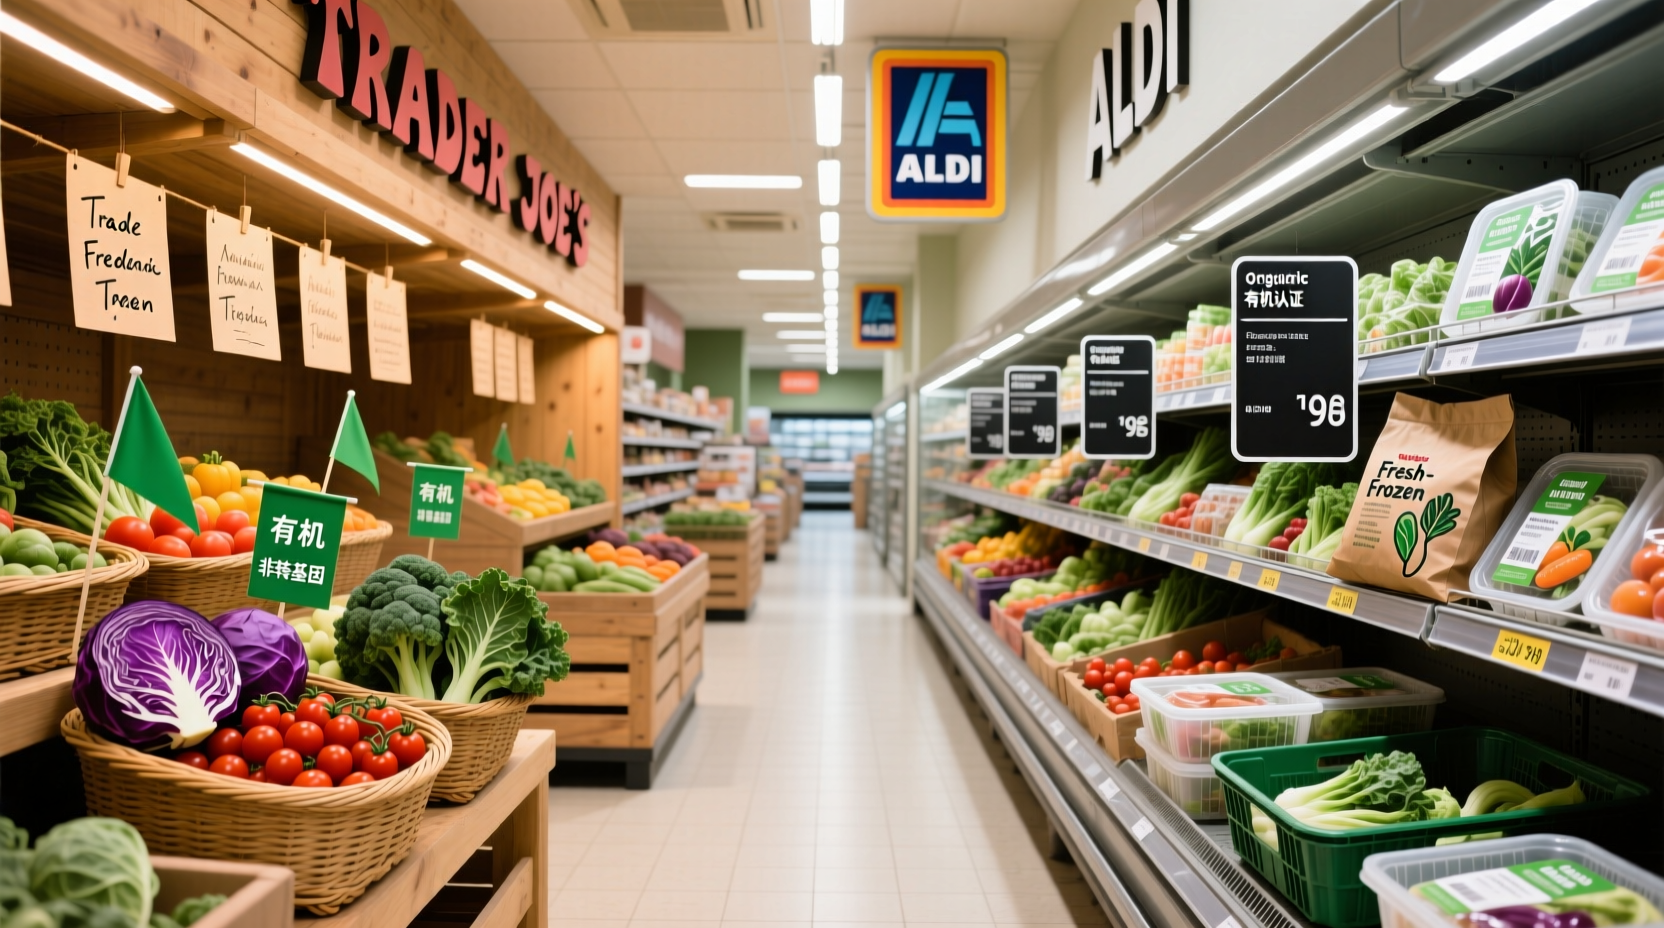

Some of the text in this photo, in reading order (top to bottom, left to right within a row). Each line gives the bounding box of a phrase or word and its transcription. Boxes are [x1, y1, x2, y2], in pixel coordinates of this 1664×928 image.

[1085, 0, 1186, 182] ALDI
[302, 0, 591, 267] TRADER JOE'S
[895, 153, 983, 184] ALDI
[81, 195, 141, 236] Trade
[1377, 460, 1434, 481] Fresh-
[419, 482, 454, 504] 有机
[1366, 479, 1425, 502] Frozen
[270, 514, 325, 549] 有机
